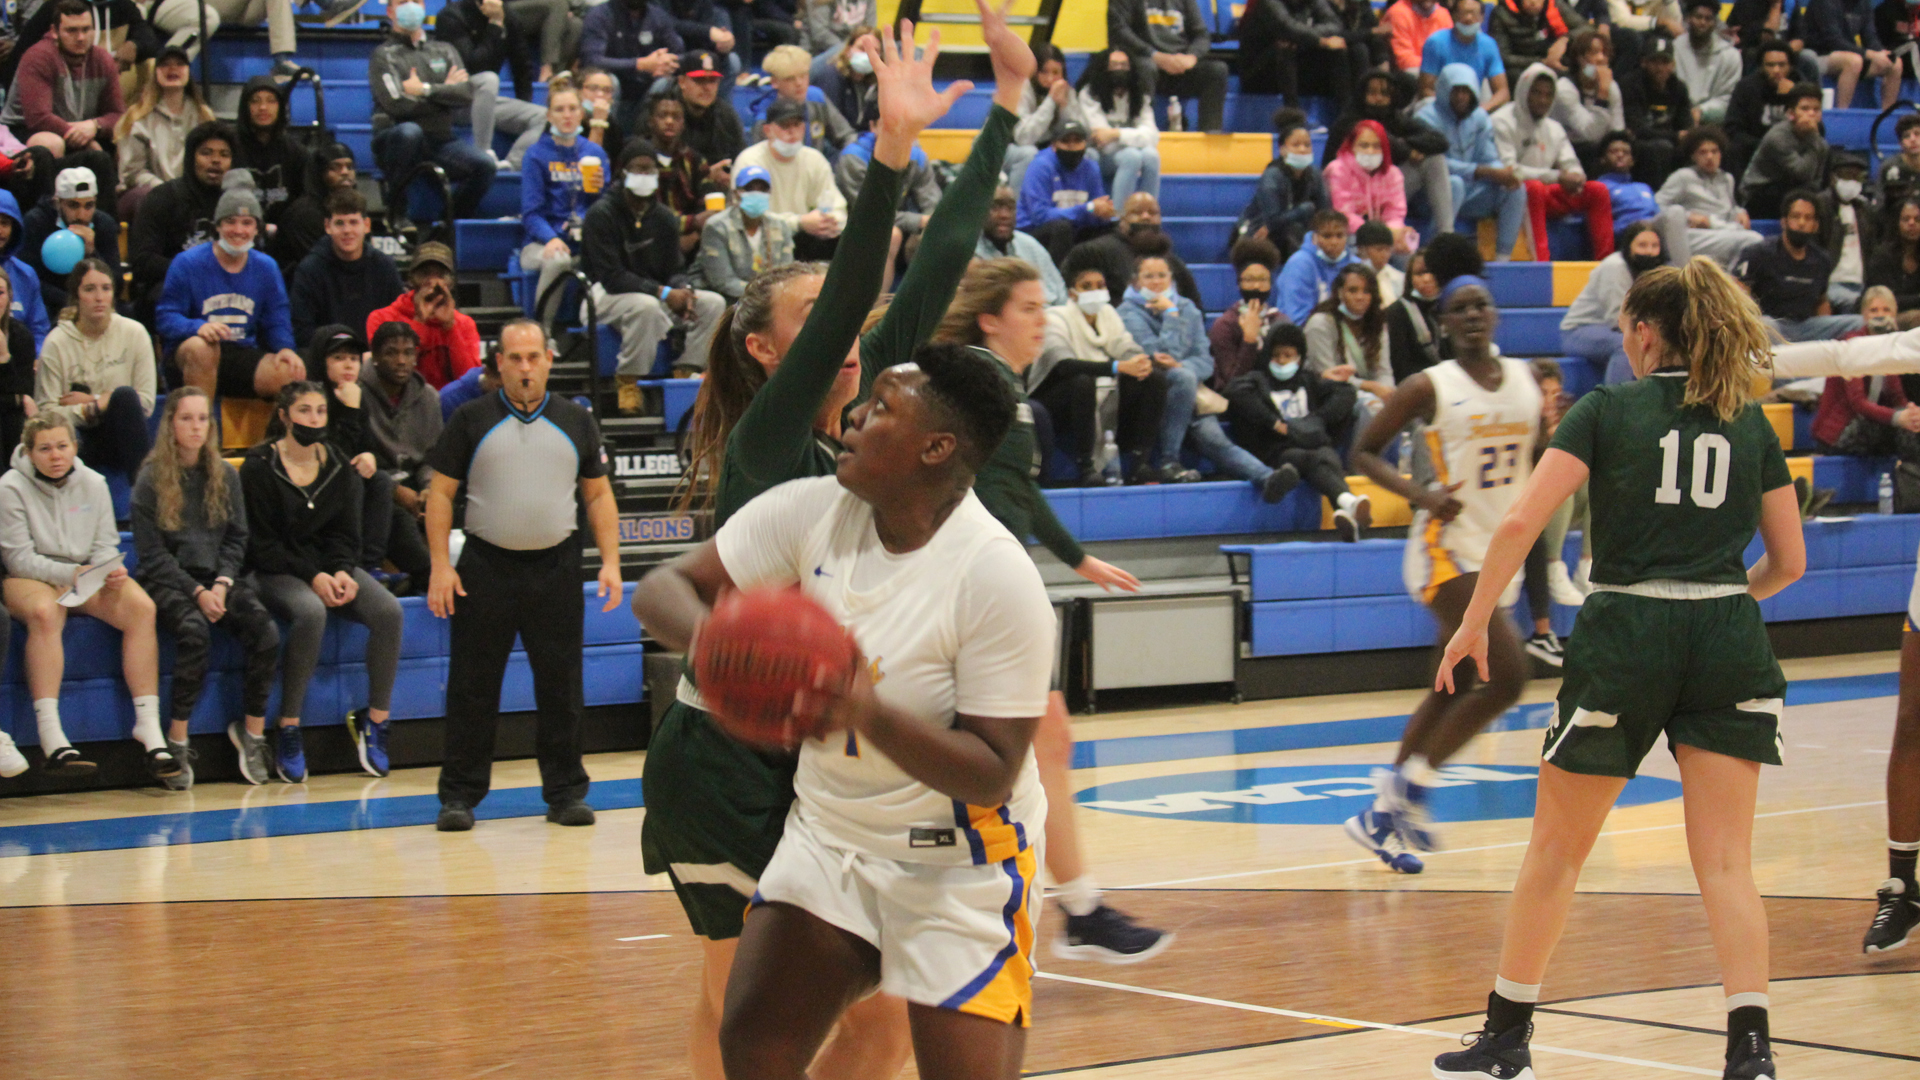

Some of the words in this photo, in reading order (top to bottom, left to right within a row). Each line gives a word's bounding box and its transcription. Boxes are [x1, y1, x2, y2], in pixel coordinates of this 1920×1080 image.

[614, 454, 682, 476] OLLEGE
[1478, 444, 1520, 491] 23
[1655, 428, 1731, 509] 10
[618, 518, 692, 541] ALCONS
